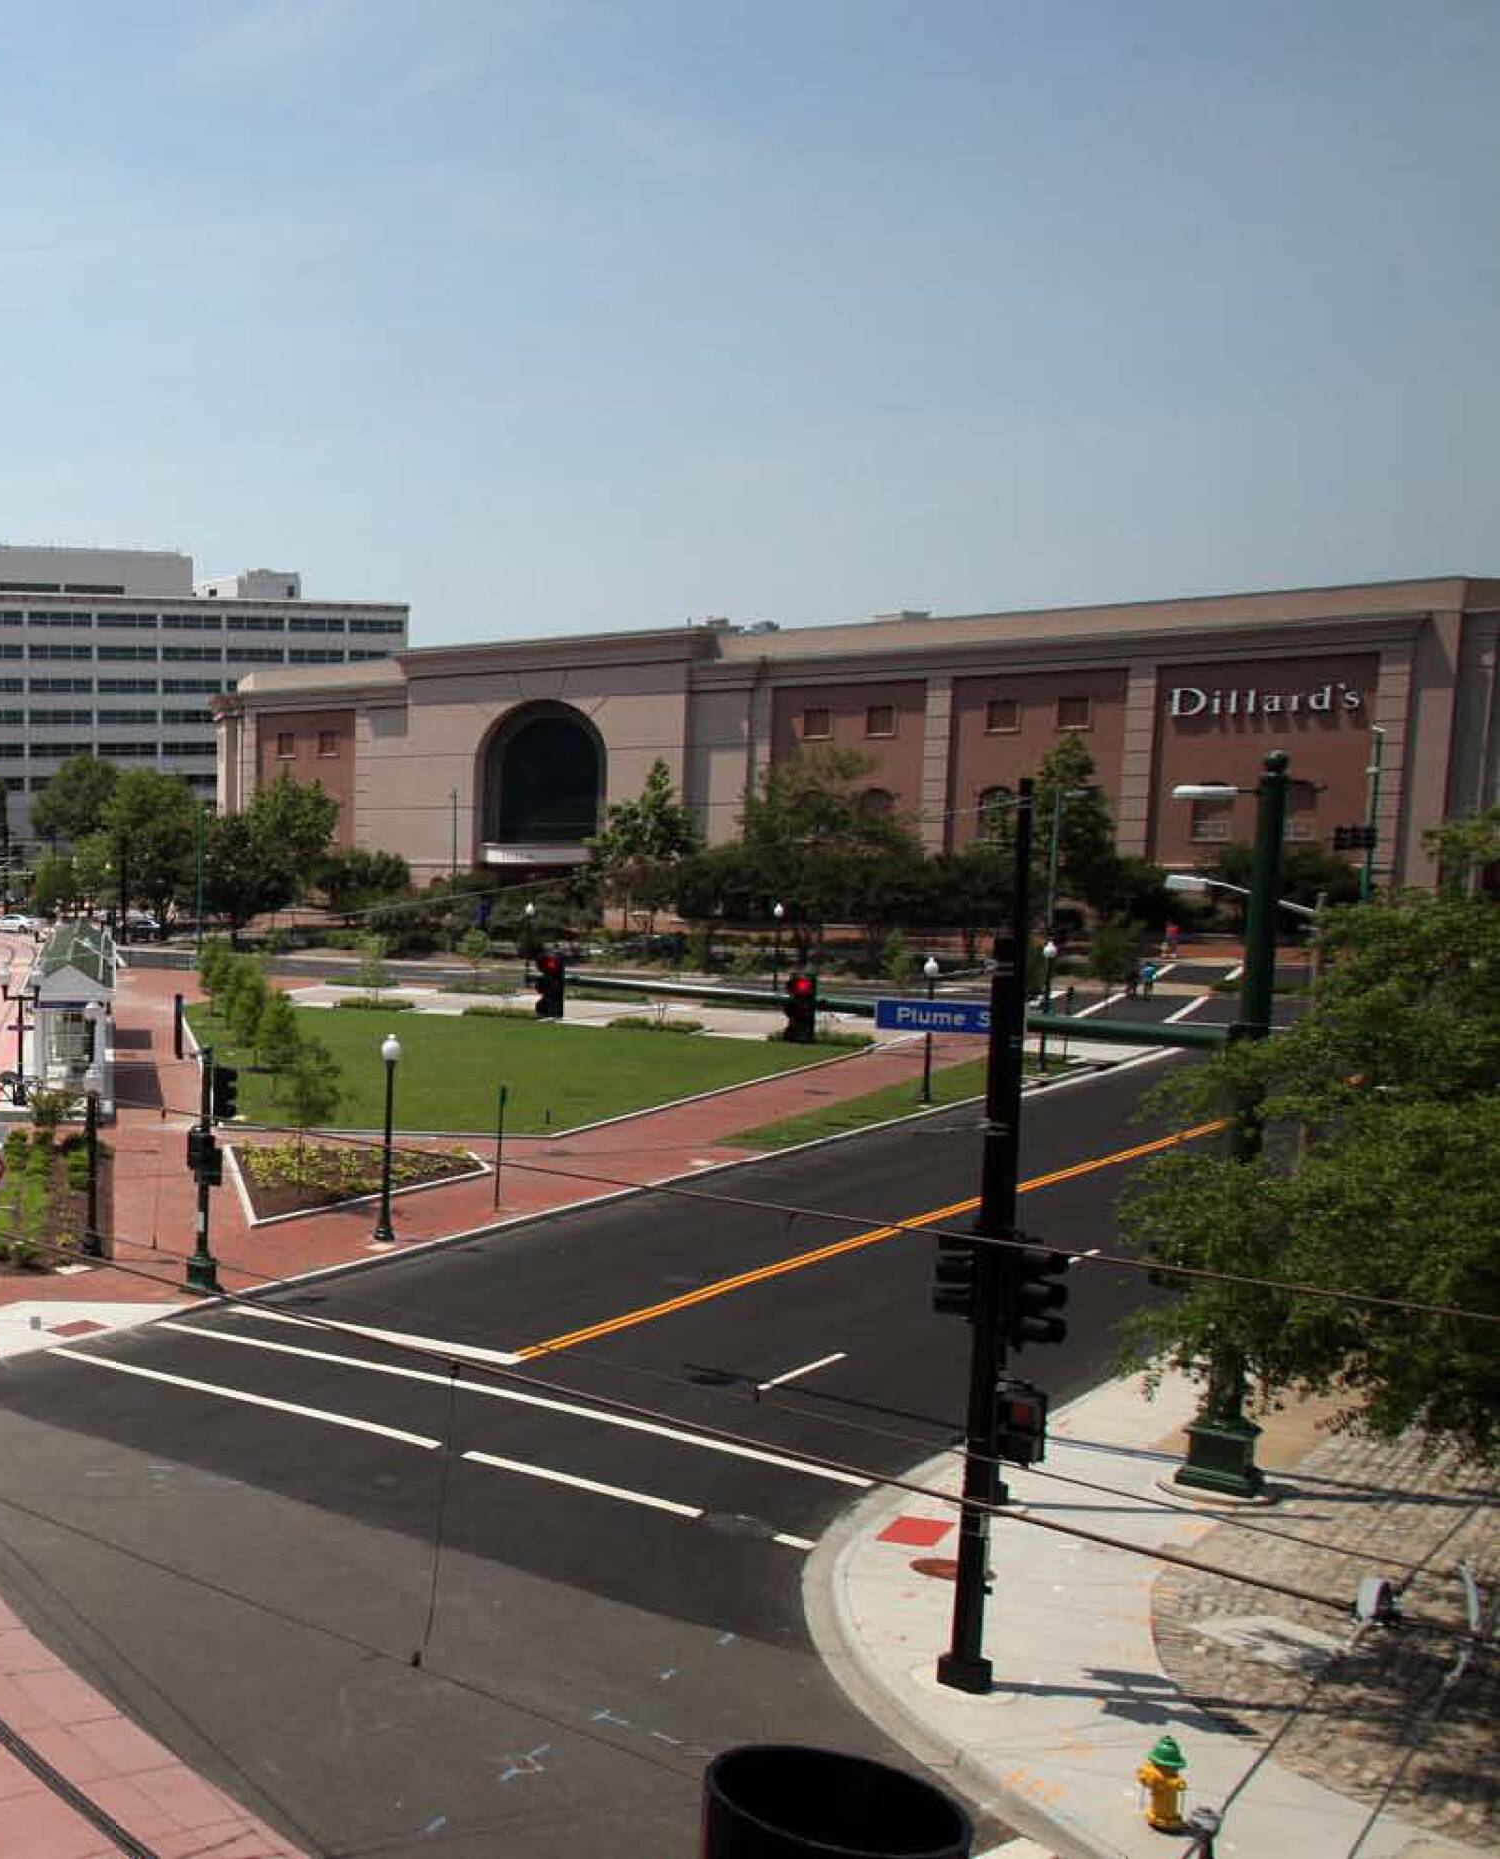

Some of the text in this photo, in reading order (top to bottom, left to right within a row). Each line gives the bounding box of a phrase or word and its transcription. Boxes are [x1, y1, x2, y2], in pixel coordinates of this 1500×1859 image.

[1171, 683, 1360, 716] Dillard's
[897, 1007, 991, 1028] Plume S
